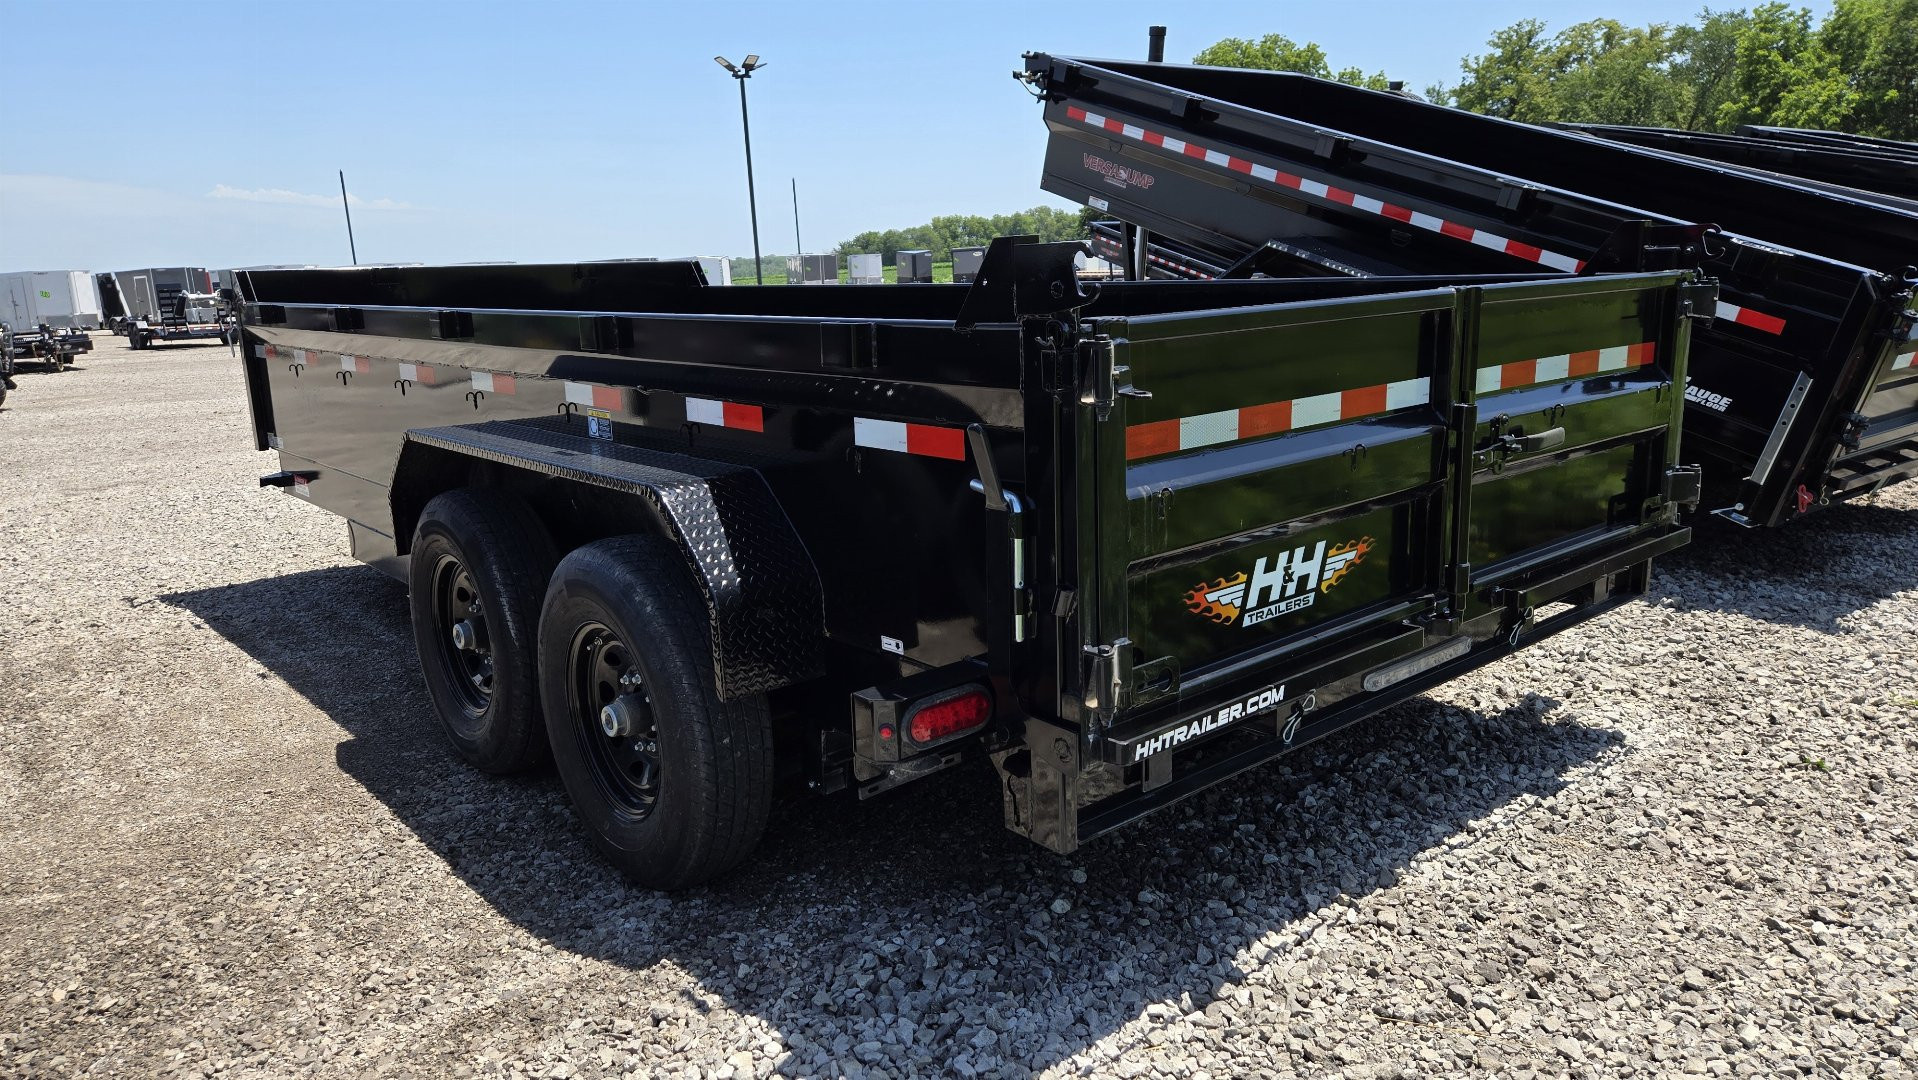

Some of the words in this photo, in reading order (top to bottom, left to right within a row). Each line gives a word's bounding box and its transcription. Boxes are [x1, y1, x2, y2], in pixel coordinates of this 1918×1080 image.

[1083, 152, 1155, 189] VERSADUMP
[1245, 539, 1327, 610] H&H
[1247, 594, 1313, 623] TRAILERS
[1134, 684, 1285, 761] HHTRAILER.COM
